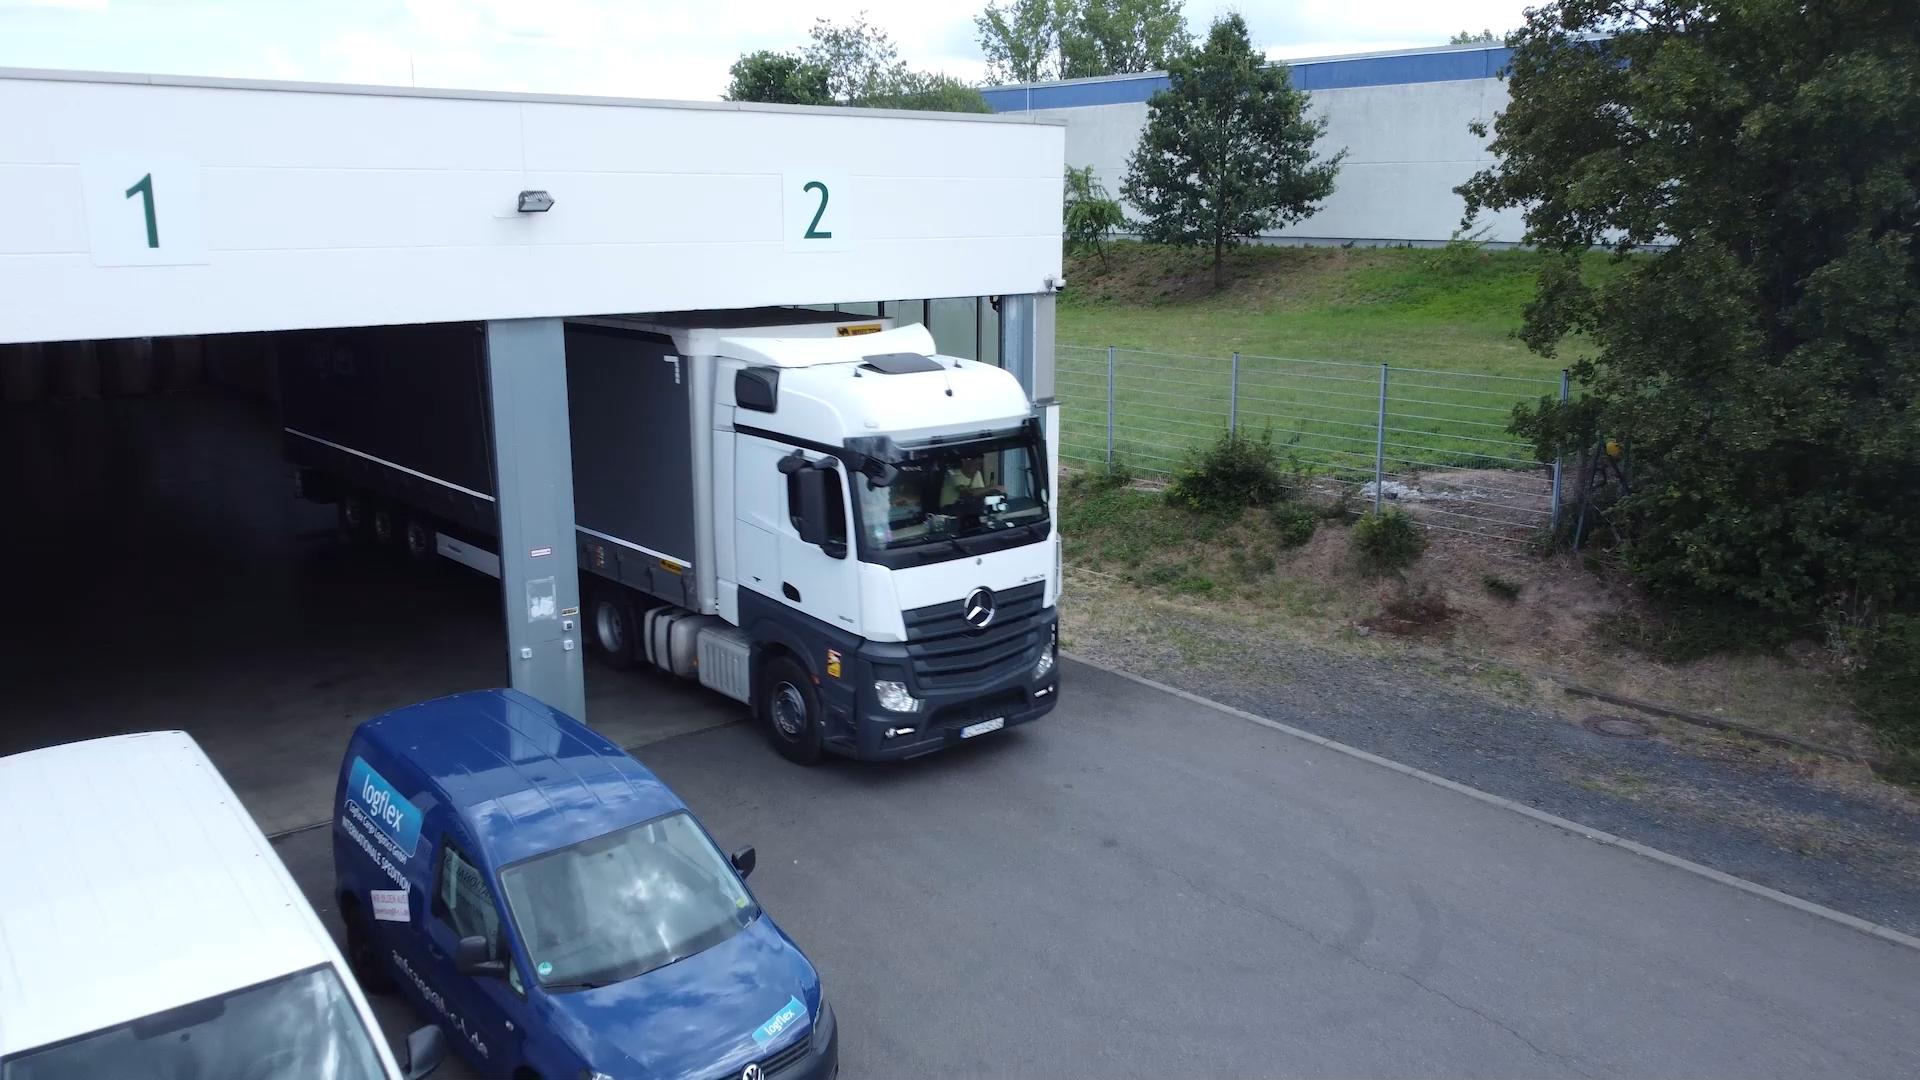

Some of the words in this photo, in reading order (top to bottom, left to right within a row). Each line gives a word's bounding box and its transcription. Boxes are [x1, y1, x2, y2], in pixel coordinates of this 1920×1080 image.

[126, 172, 160, 248] 1
[803, 181, 832, 239] 2
[362, 774, 403, 832] logflex
[764, 1009, 795, 1036] logflex
